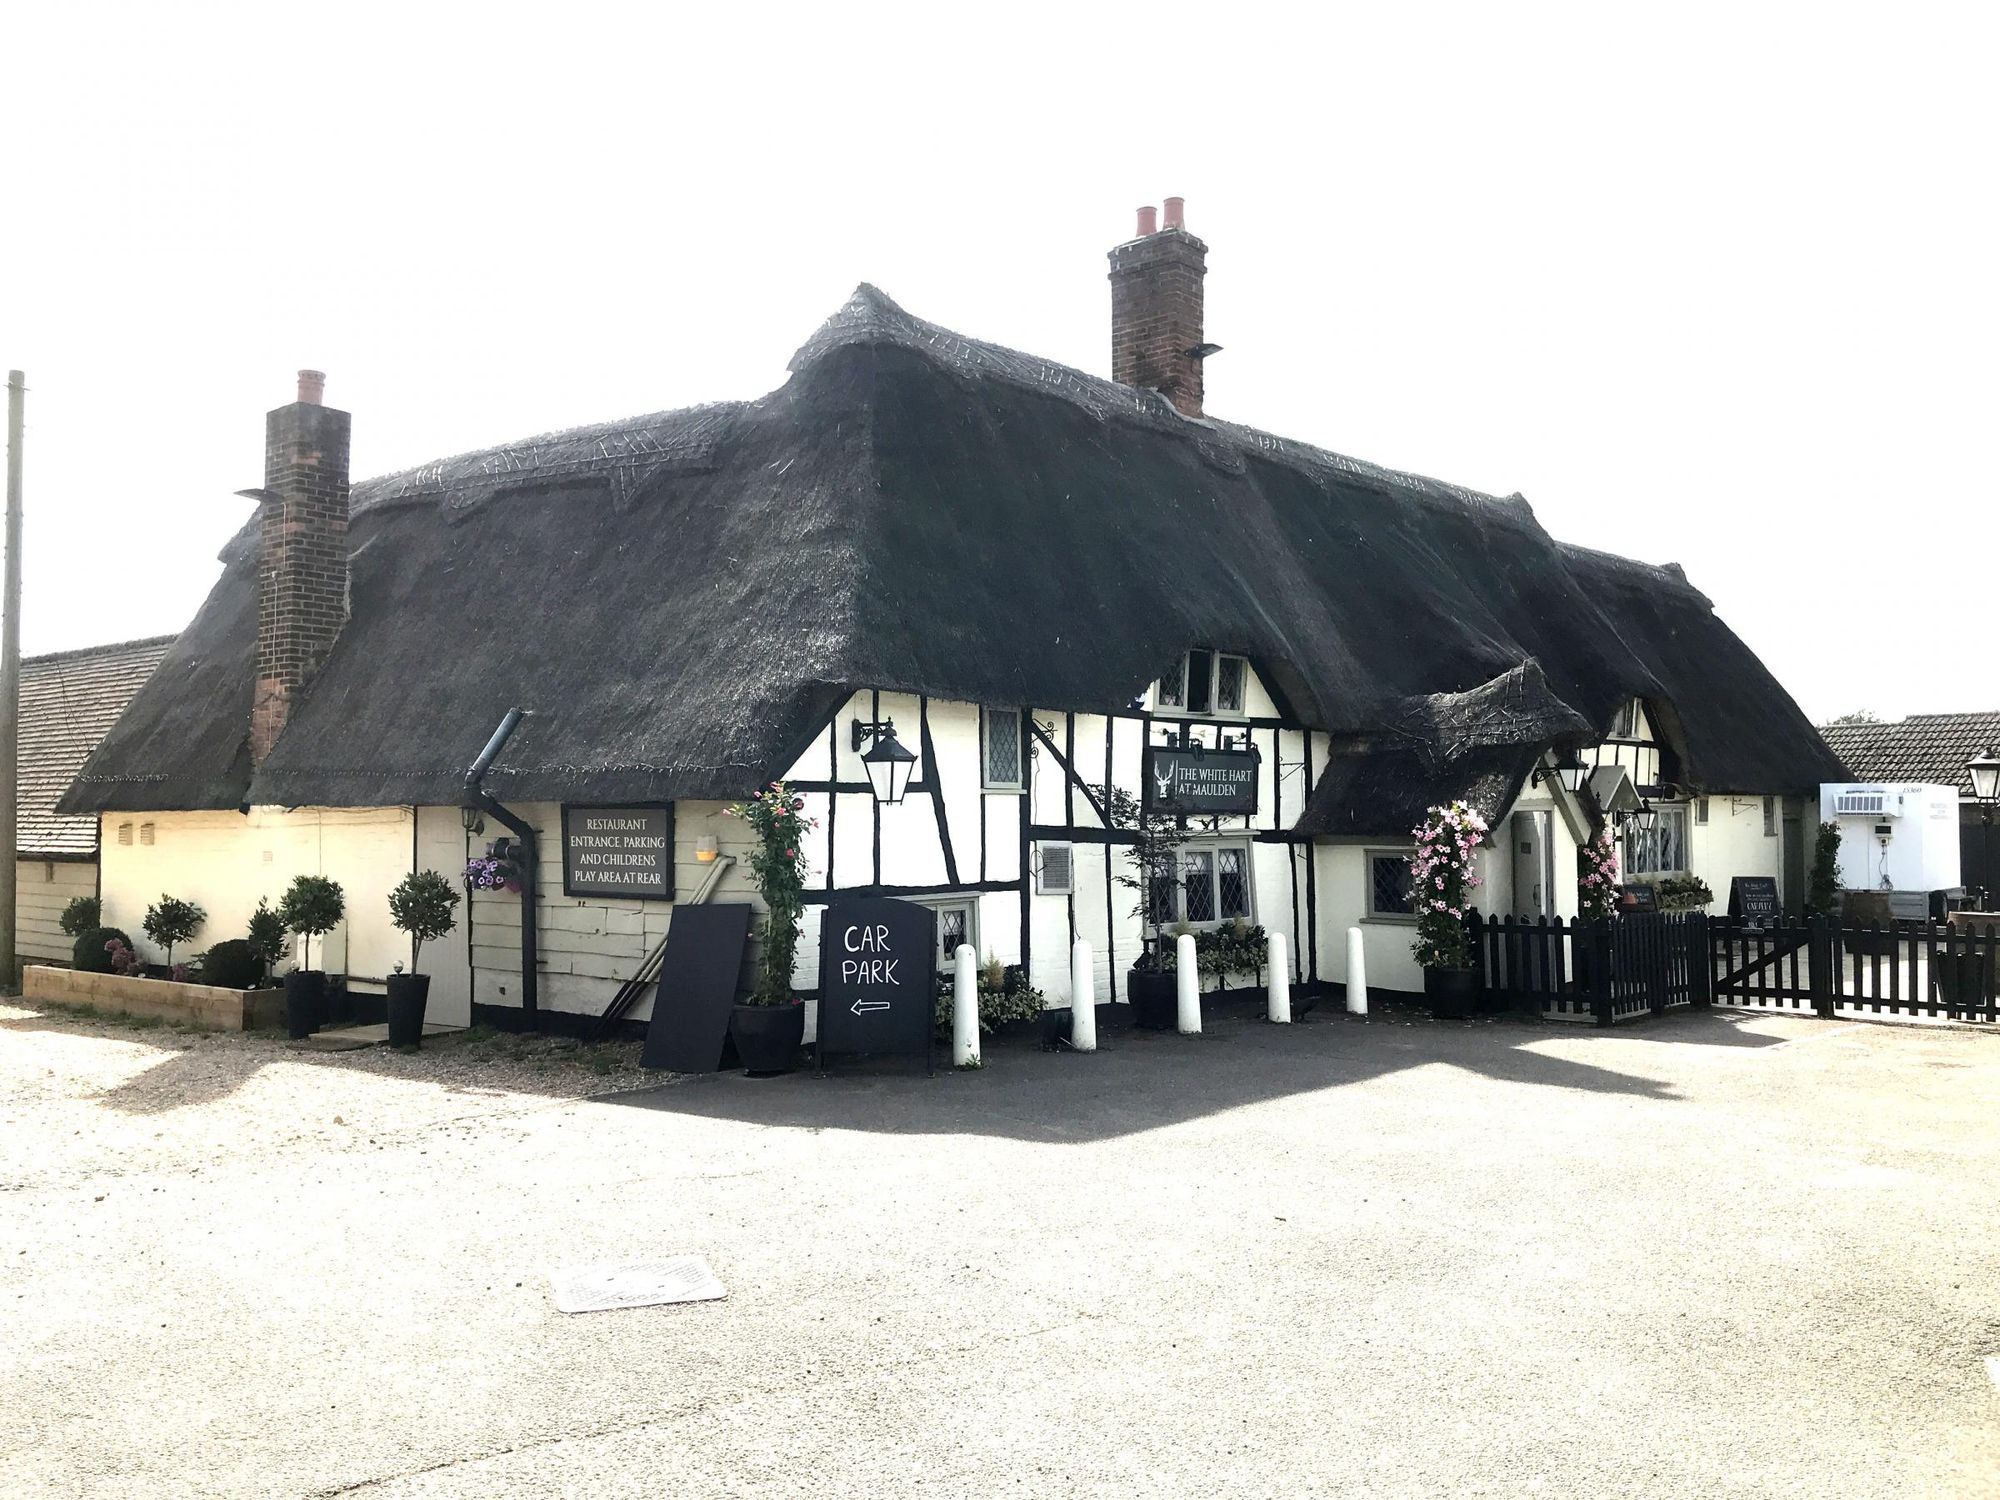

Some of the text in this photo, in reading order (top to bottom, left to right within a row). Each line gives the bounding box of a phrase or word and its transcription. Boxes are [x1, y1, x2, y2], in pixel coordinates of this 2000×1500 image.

[1179, 767, 1252, 782] THE WHITE HART
[1179, 783, 1236, 796] AT MAULDEN
[586, 819, 648, 830] RESTAURANT
[570, 835, 665, 849] ENTRANCE PARKING
[580, 853, 656, 867] AND CHILDRENS
[575, 870, 662, 885] PLAY AREA AT REAR
[844, 924, 892, 953] CAR
[842, 959, 900, 985] PARK
